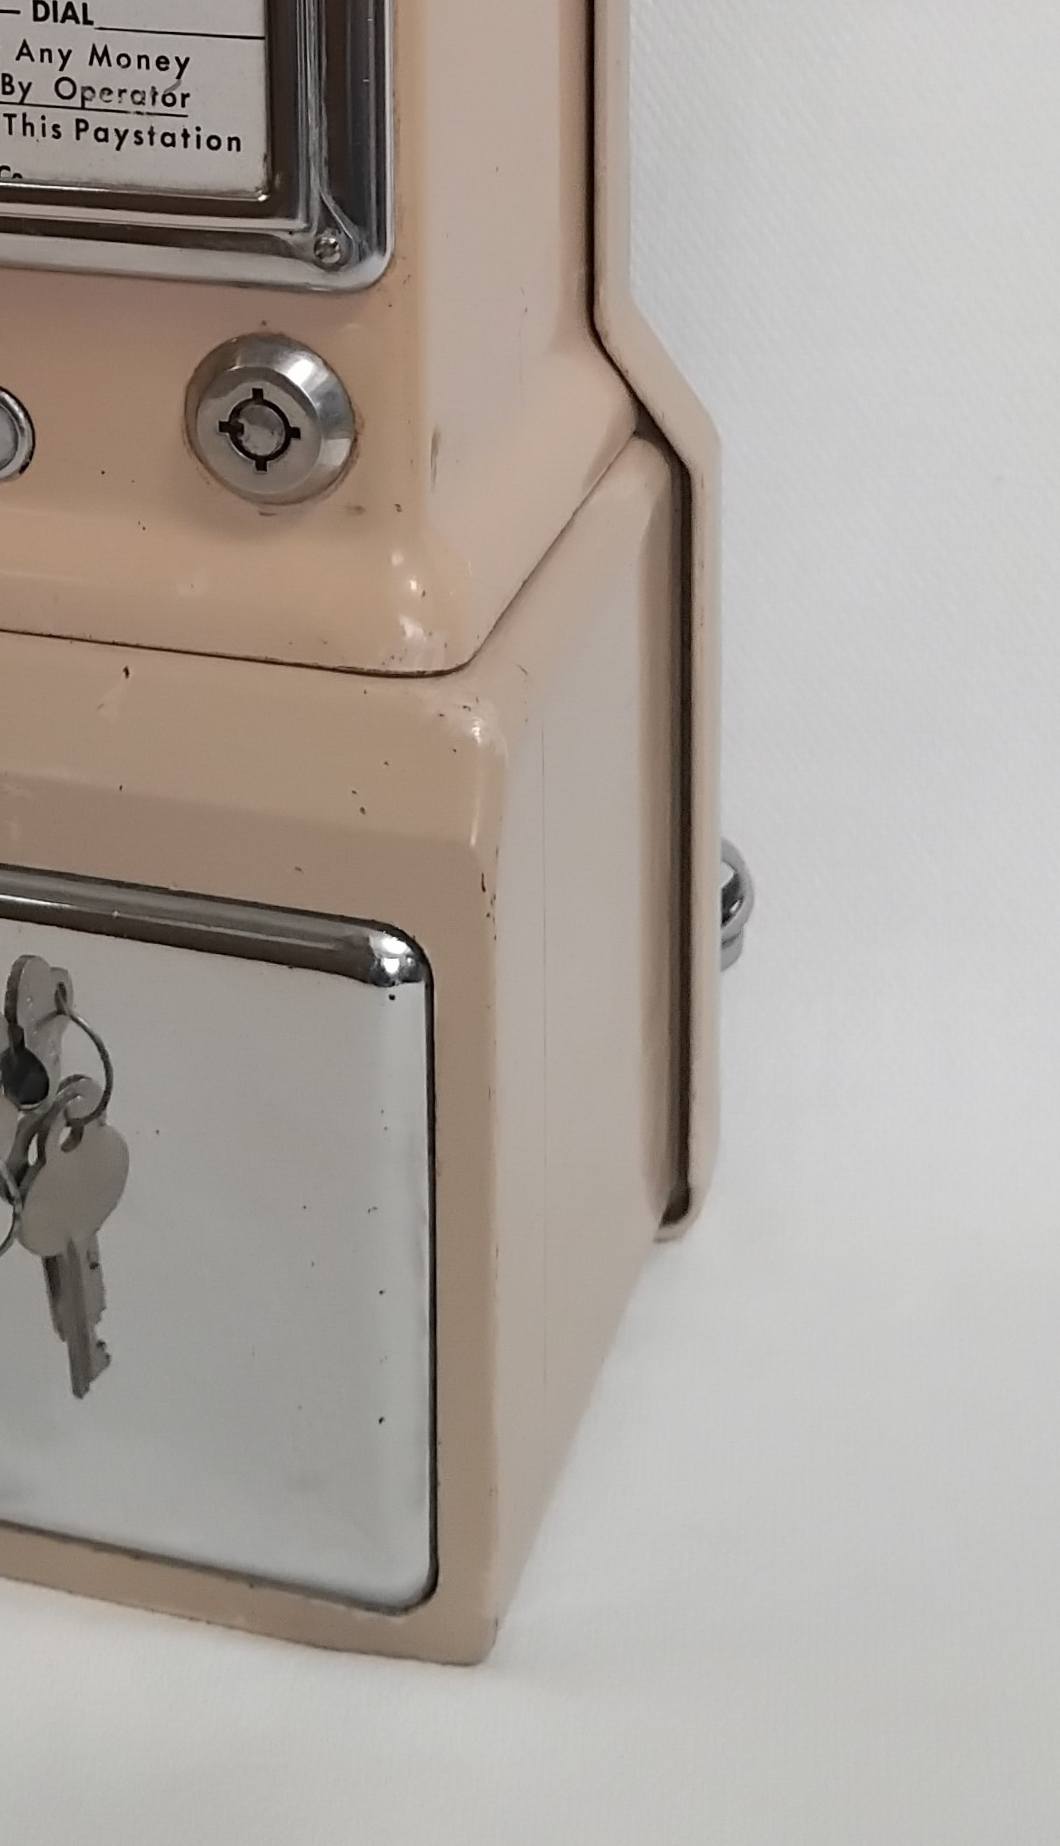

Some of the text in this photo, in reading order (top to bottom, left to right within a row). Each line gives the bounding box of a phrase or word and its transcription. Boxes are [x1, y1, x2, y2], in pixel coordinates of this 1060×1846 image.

[32, 0, 94, 26] DIAL
[15, 39, 72, 71] Any
[89, 43, 190, 79] Money
[1, 73, 32, 103] By
[54, 76, 190, 109] Operator
[3, 112, 62, 140] This
[75, 118, 242, 152] Paystation
